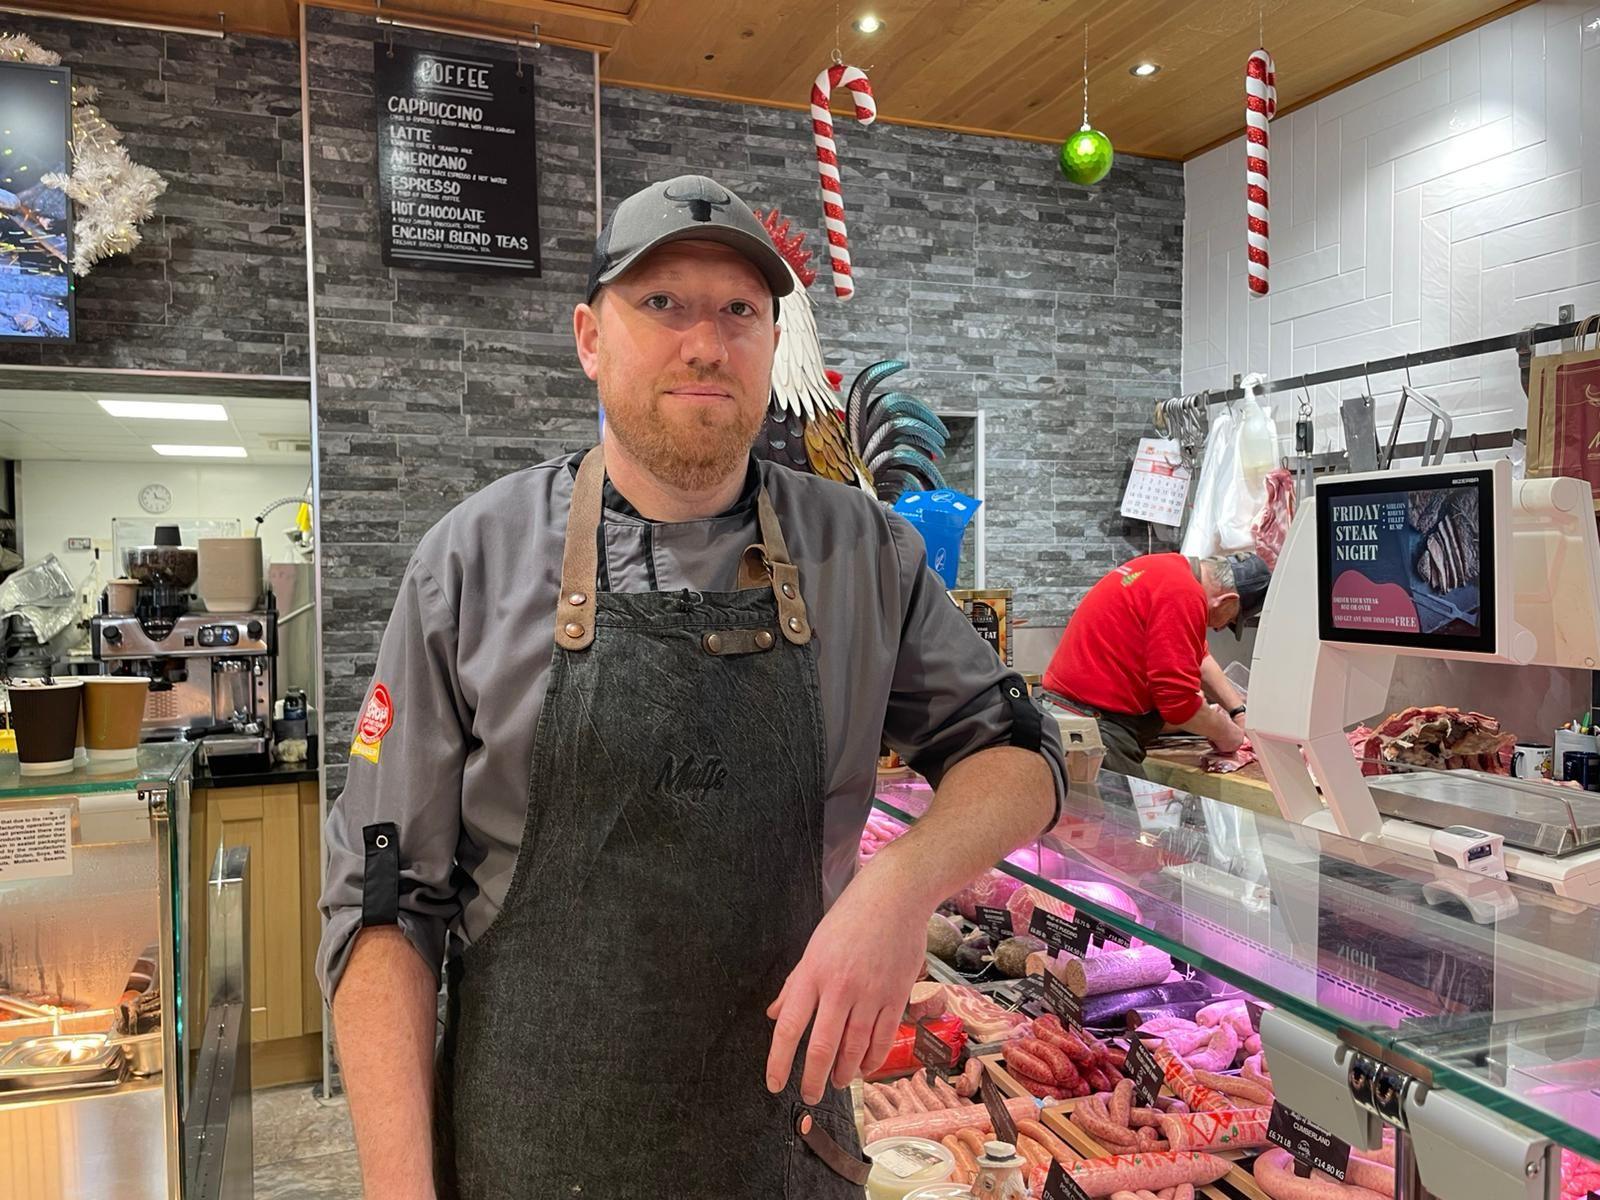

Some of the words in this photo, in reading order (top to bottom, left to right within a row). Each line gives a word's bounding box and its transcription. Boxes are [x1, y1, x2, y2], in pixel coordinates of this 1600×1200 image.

[420, 61, 489, 90] COFFEE
[388, 96, 483, 122] CAPPUCCINO
[390, 125, 433, 143] LATTE
[390, 148, 467, 171] AMERICANO
[391, 175, 461, 196] ESPRESSO
[391, 201, 415, 216] HOT
[417, 204, 487, 223] CHOCOLATE
[391, 224, 445, 242] ENGLISH
[449, 230, 491, 247] BLEND
[495, 234, 529, 250] TEAS
[1333, 504, 1380, 522] FRIDAY
[1335, 524, 1379, 542] STEAK
[1336, 544, 1379, 561] NIGHT
[1395, 616, 1417, 627] FREE
[984, 631, 997, 640] FAT
[37, 838, 67, 846] packaging
[1268, 1129, 1284, 1144] £6.71
[1283, 1138, 1292, 1149] LB
[1292, 1121, 1331, 1147] CUMBERLAND
[1313, 1156, 1336, 1175] £14.80
[1334, 1168, 1346, 1180] KG
